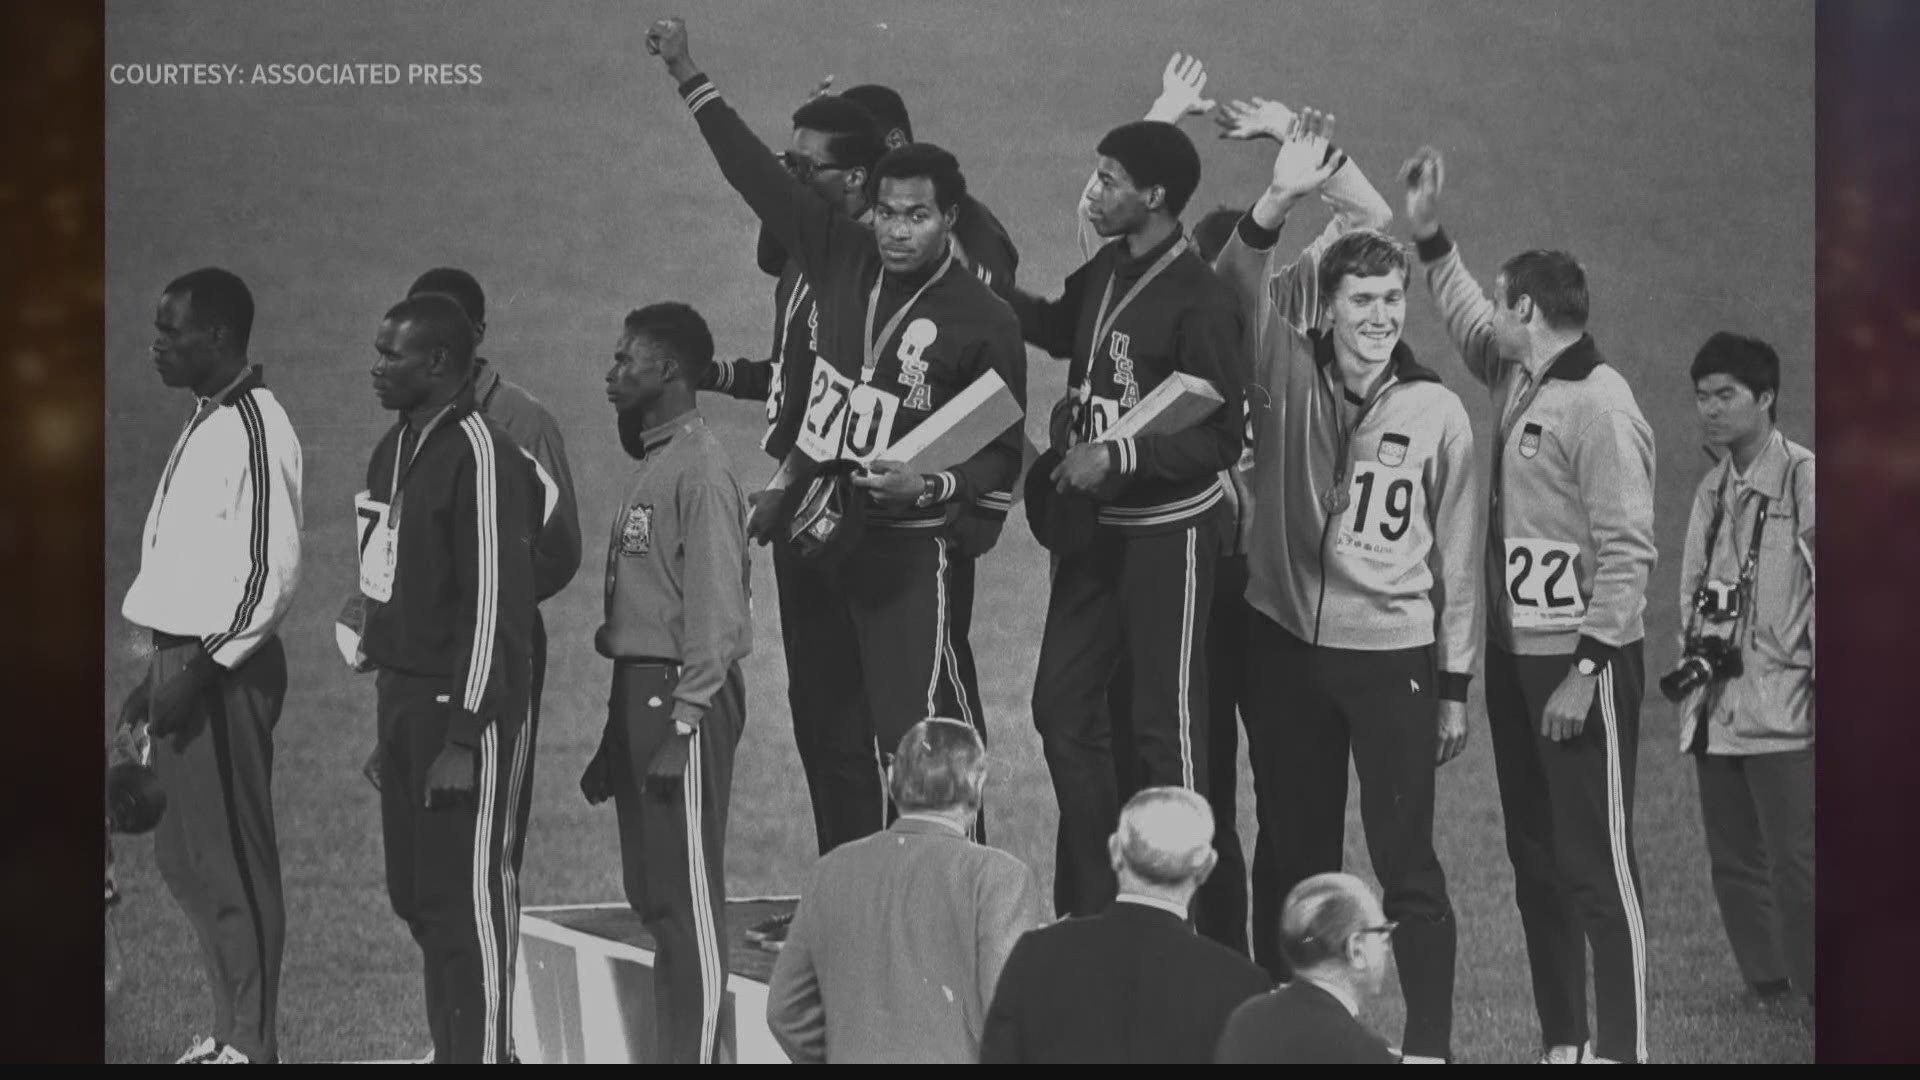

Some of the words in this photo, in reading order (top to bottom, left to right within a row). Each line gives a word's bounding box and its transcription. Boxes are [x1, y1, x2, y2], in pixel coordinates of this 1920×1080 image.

[1109, 330, 1140, 409] USA
[357, 506, 381, 564] 7
[1353, 471, 1413, 542] 19
[1508, 546, 1575, 608] 22
